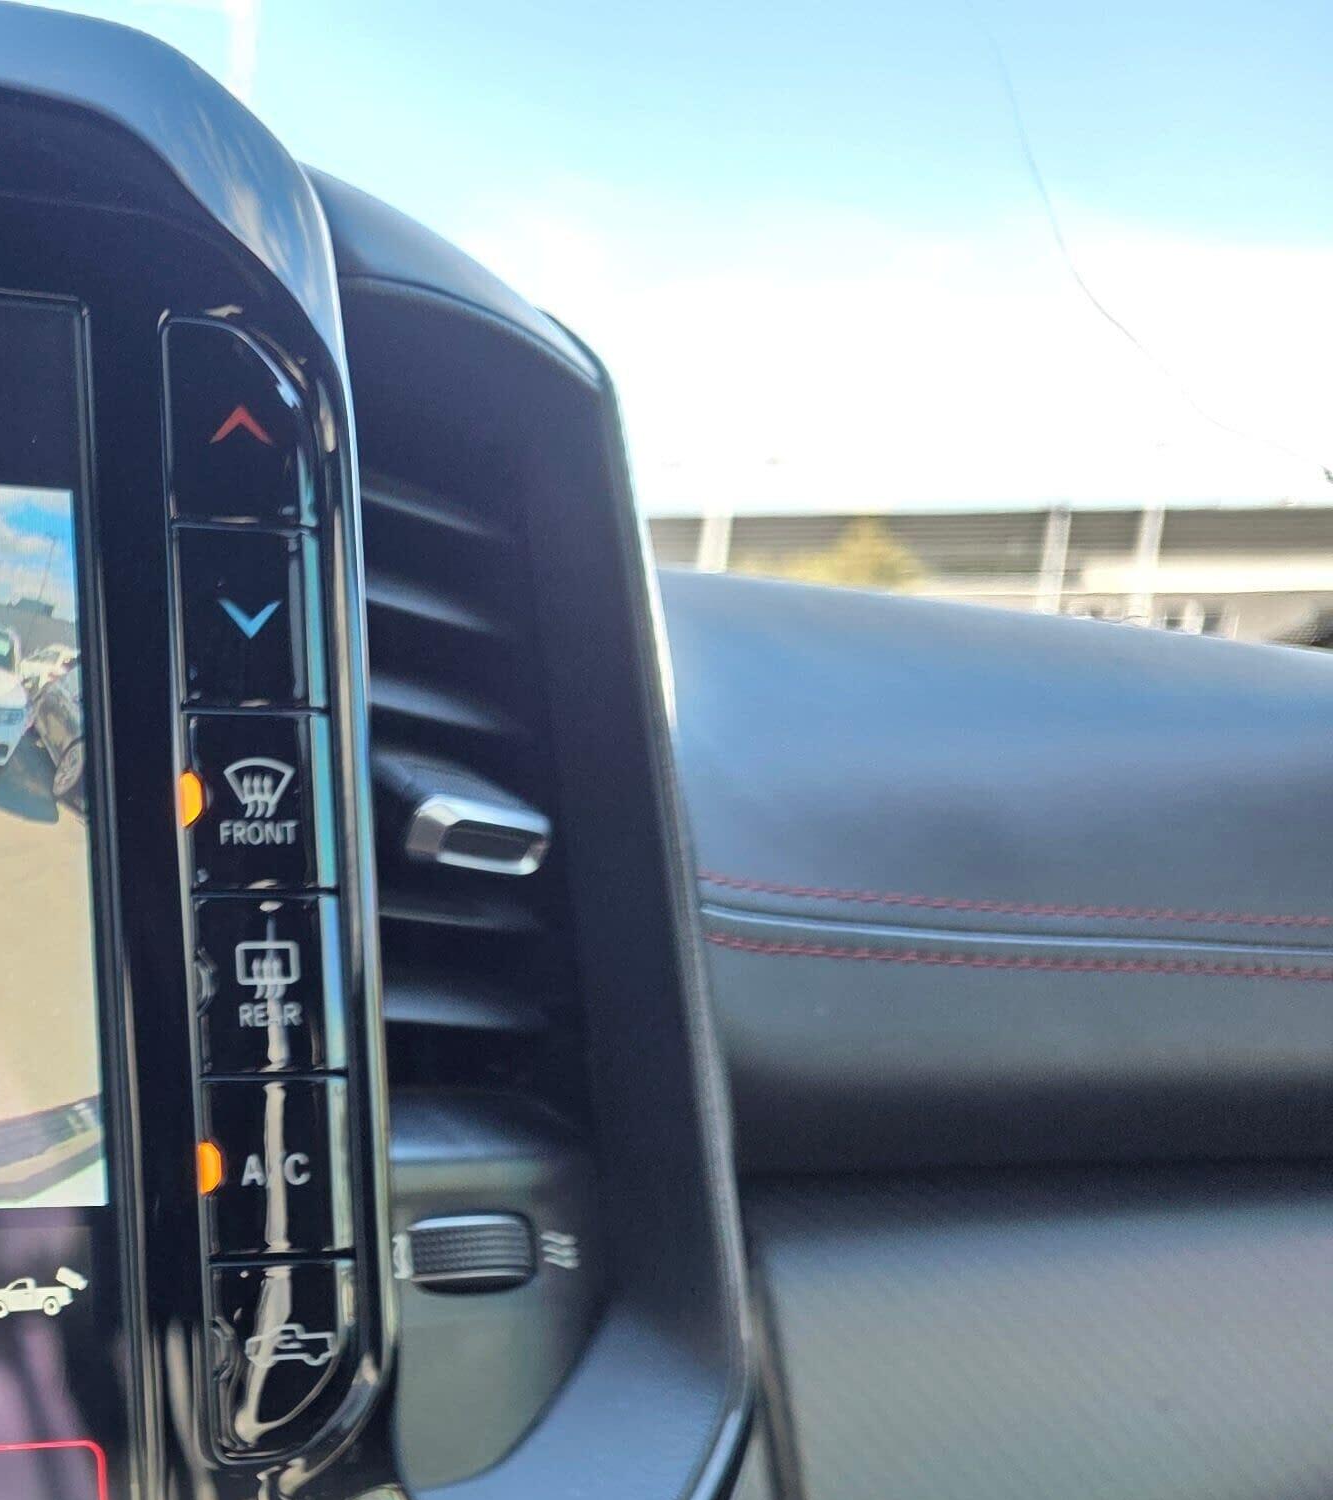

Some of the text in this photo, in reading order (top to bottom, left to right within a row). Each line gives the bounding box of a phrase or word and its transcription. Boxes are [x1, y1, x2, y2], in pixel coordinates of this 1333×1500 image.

[219, 820, 297, 847] FRONT
[238, 1002, 303, 1028] RER
[240, 1152, 312, 1188] AC
